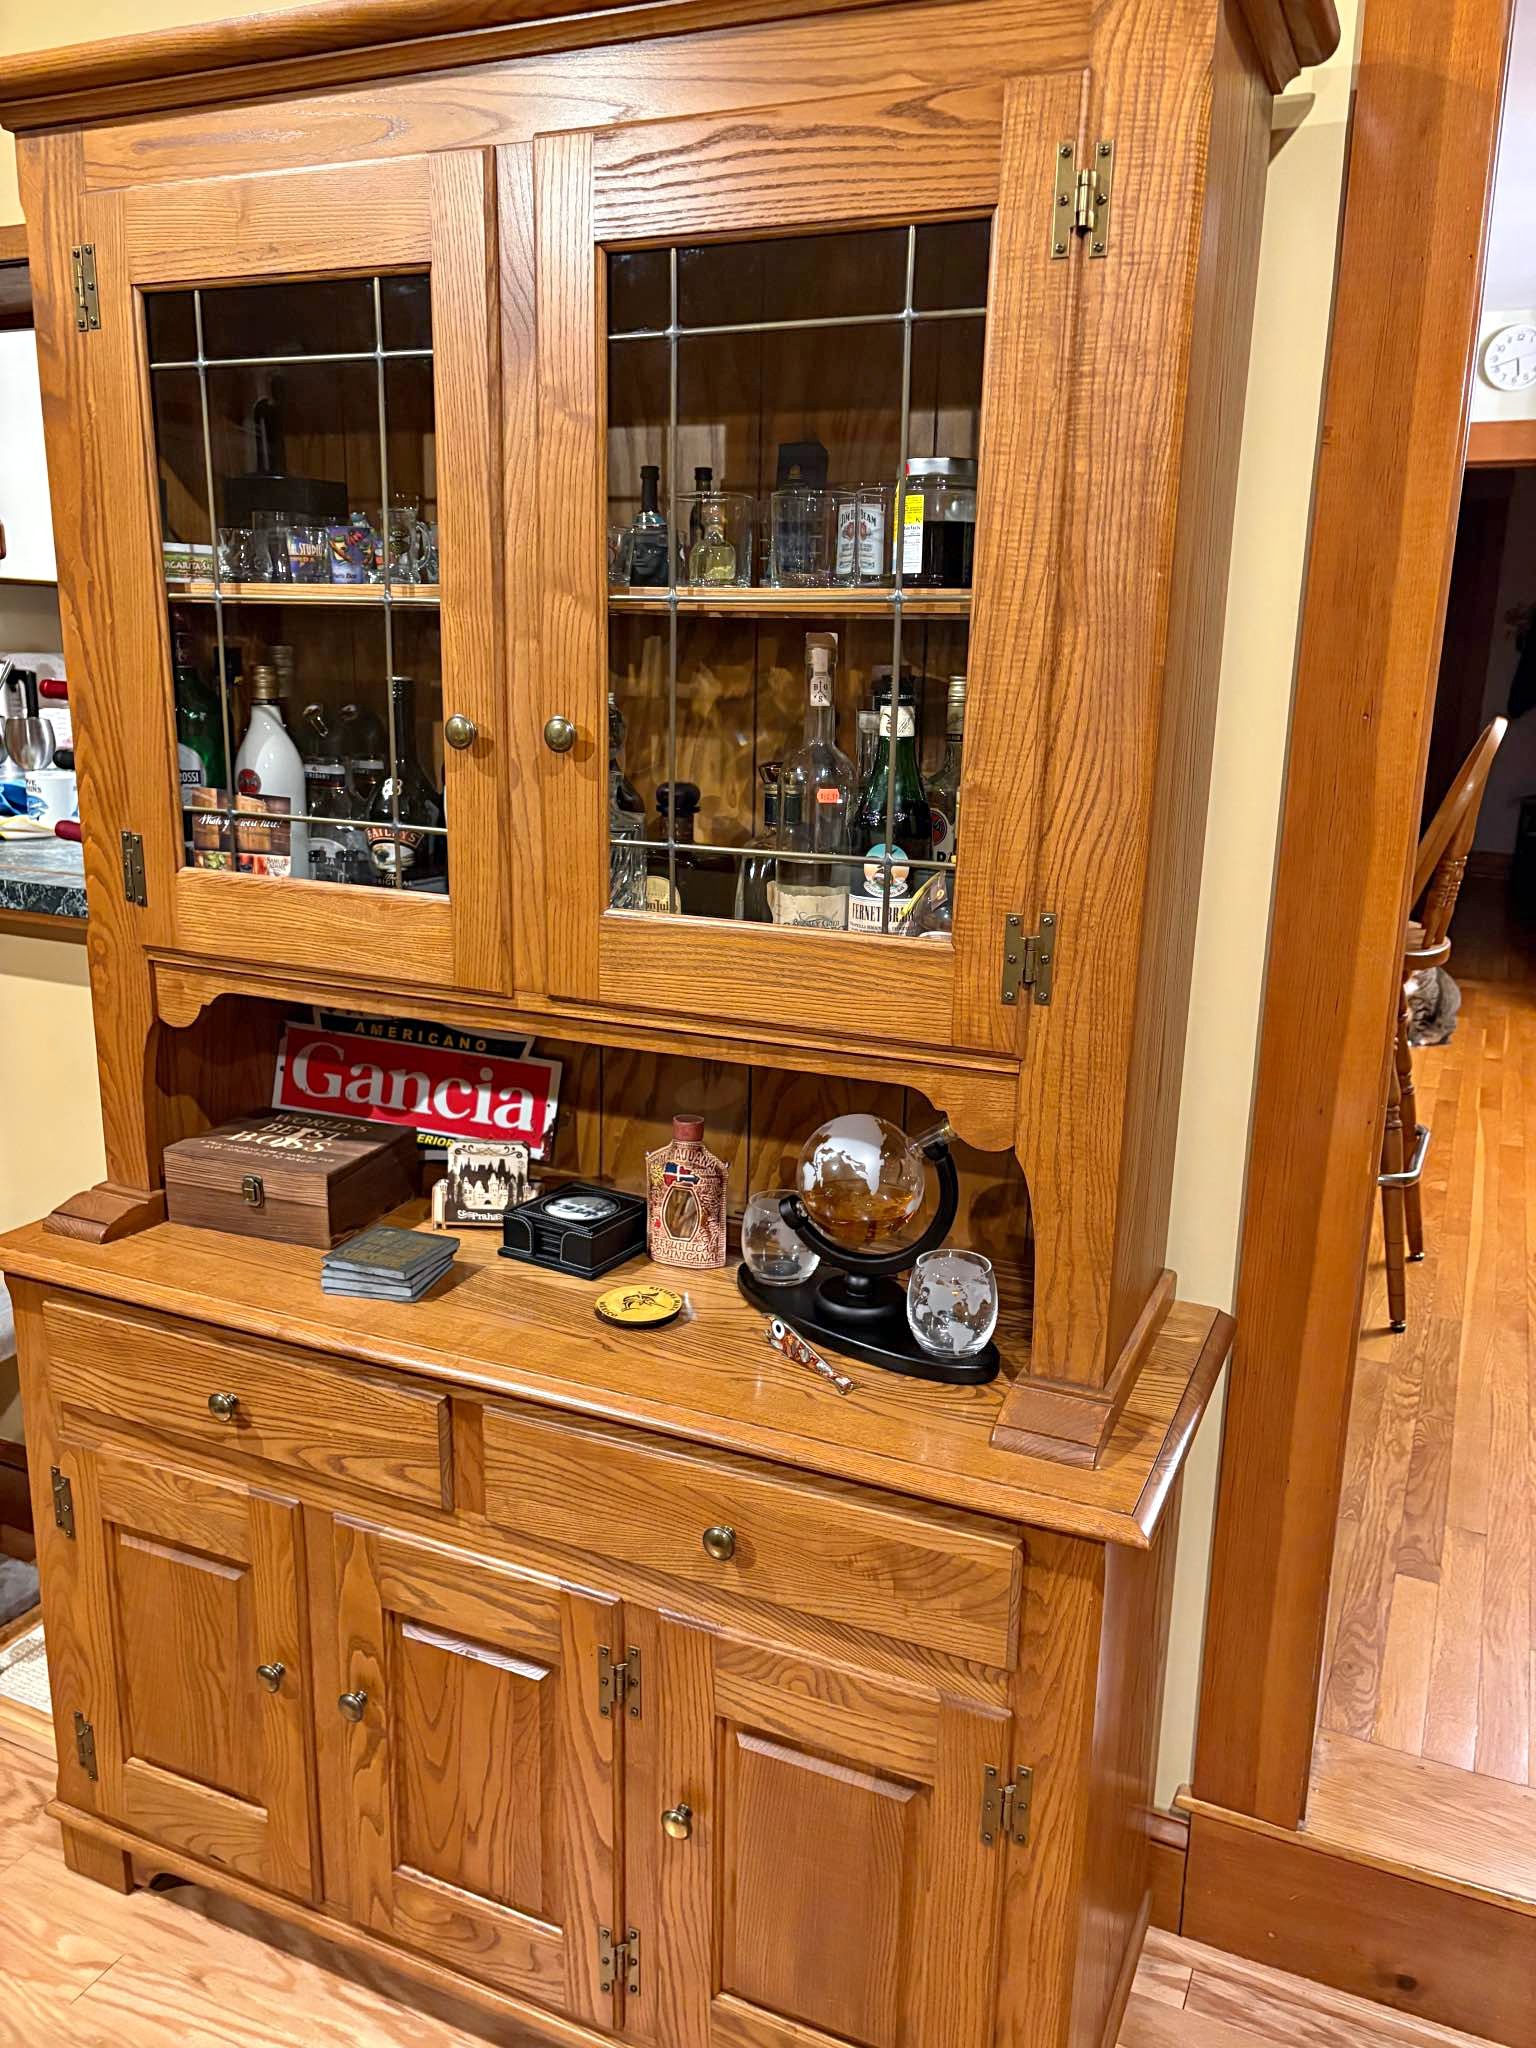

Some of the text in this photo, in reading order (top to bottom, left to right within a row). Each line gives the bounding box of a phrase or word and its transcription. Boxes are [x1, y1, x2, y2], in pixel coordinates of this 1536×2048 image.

[180, 771, 199, 782] OSSI
[366, 827, 417, 843] BAILYS
[355, 1021, 487, 1051] AMERICANO
[292, 1041, 536, 1132] Gancia
[259, 1122, 348, 1141] BEST
[274, 1113, 372, 1133] WORLD'S
[226, 1131, 332, 1153] BOSS
[416, 1134, 455, 1148] ERIOR
